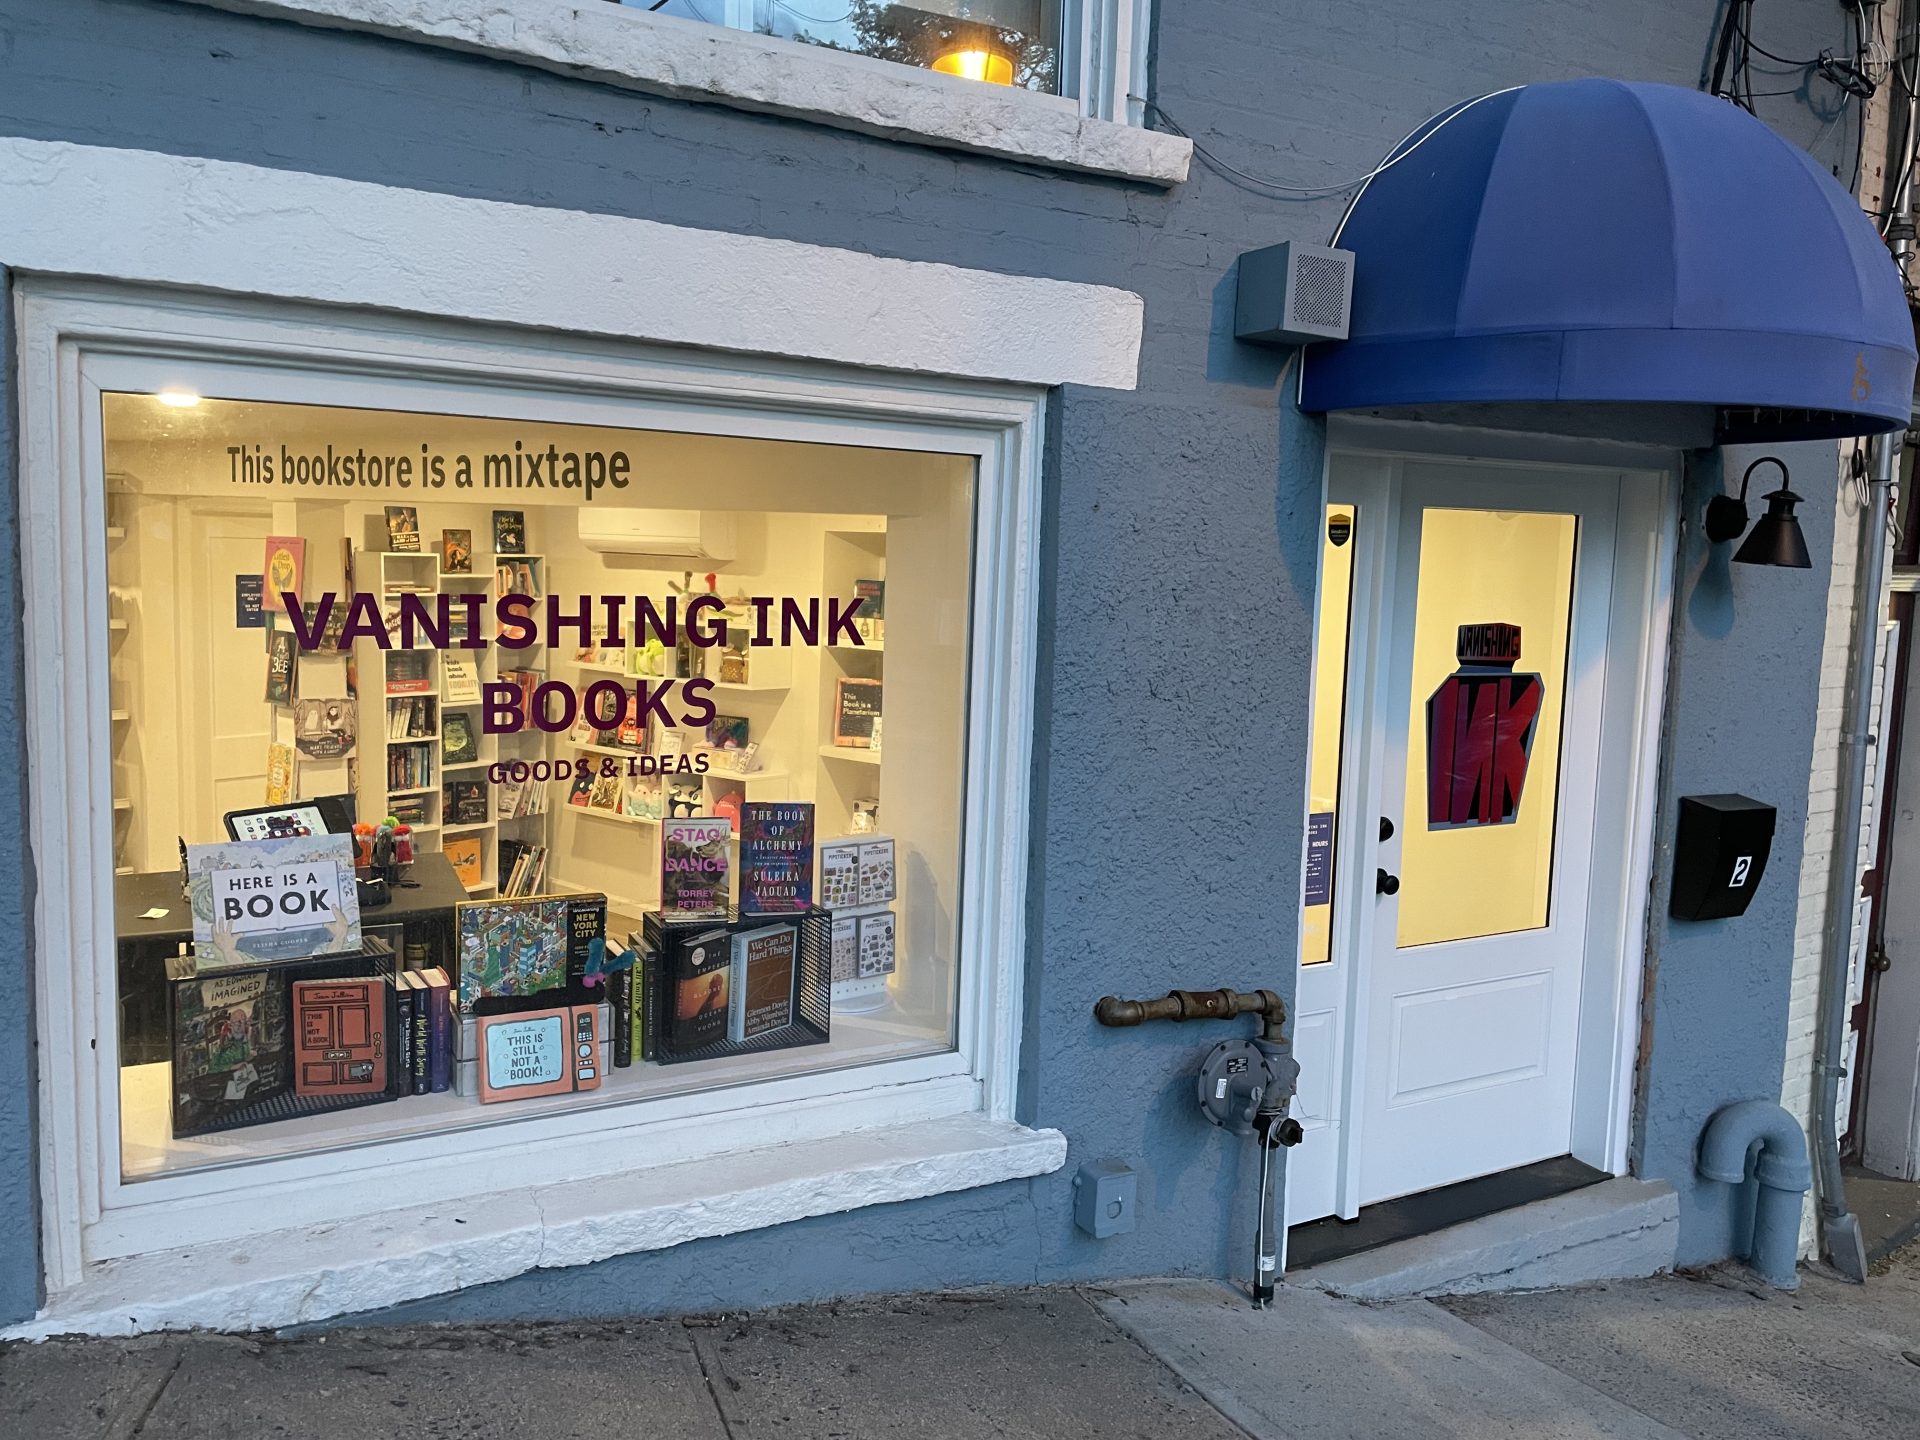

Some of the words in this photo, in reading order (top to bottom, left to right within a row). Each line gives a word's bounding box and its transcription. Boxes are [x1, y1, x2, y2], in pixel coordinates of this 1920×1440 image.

[227, 444, 274, 484] This
[281, 444, 413, 488] bookstore
[421, 443, 446, 488] is
[454, 454, 473, 488] a
[483, 440, 630, 501] mixtape
[280, 591, 727, 650] VANISHING
[751, 597, 865, 647] INK
[1458, 625, 1520, 657] VANISHING
[482, 678, 717, 735] BOOKS
[843, 700, 859, 708] Book
[843, 707, 880, 716] Planetarium
[1428, 676, 1541, 825] INK
[488, 758, 590, 784] GOODS
[600, 757, 618, 779] &
[627, 753, 709, 777] IDEAS
[752, 811, 771, 820] THE
[777, 811, 805, 820] BOOK
[672, 828, 720, 842] STAG
[771, 826, 784, 836] OF
[752, 841, 802, 851] ALCHEMY
[665, 858, 728, 872] DANCE
[1731, 858, 1749, 886] 2
[229, 876, 274, 891] HERE
[283, 873, 297, 886] IS
[306, 872, 317, 885] A
[753, 872, 799, 882] SULEIKA
[677, 889, 715, 897] TORREY
[755, 886, 797, 897] JAOUAD
[223, 889, 331, 921] BOOK
[575, 913, 596, 921] NEW
[573, 921, 598, 930] YORK
[575, 929, 596, 938] CITY
[751, 942, 763, 951] We
[764, 938, 779, 948] Can
[779, 934, 791, 943] Do
[749, 950, 767, 962] Hard
[768, 944, 792, 957] Things
[211, 981, 261, 1001] IMAGINED
[214, 980, 223, 988] AS
[746, 1004, 772, 1018] Glennon
[772, 1000, 788, 1010] Doyle
[761, 1008, 789, 1021] Wambach
[416, 1018, 428, 1037] World
[770, 1017, 787, 1027] Doyle
[507, 1034, 531, 1046] THIS
[534, 1033, 543, 1043] IS
[512, 1045, 538, 1056] STILL
[415, 1057, 427, 1076] Saving
[511, 1057, 531, 1067] NOT
[534, 1056, 541, 1065] A
[510, 1066, 543, 1080] BOOK!
